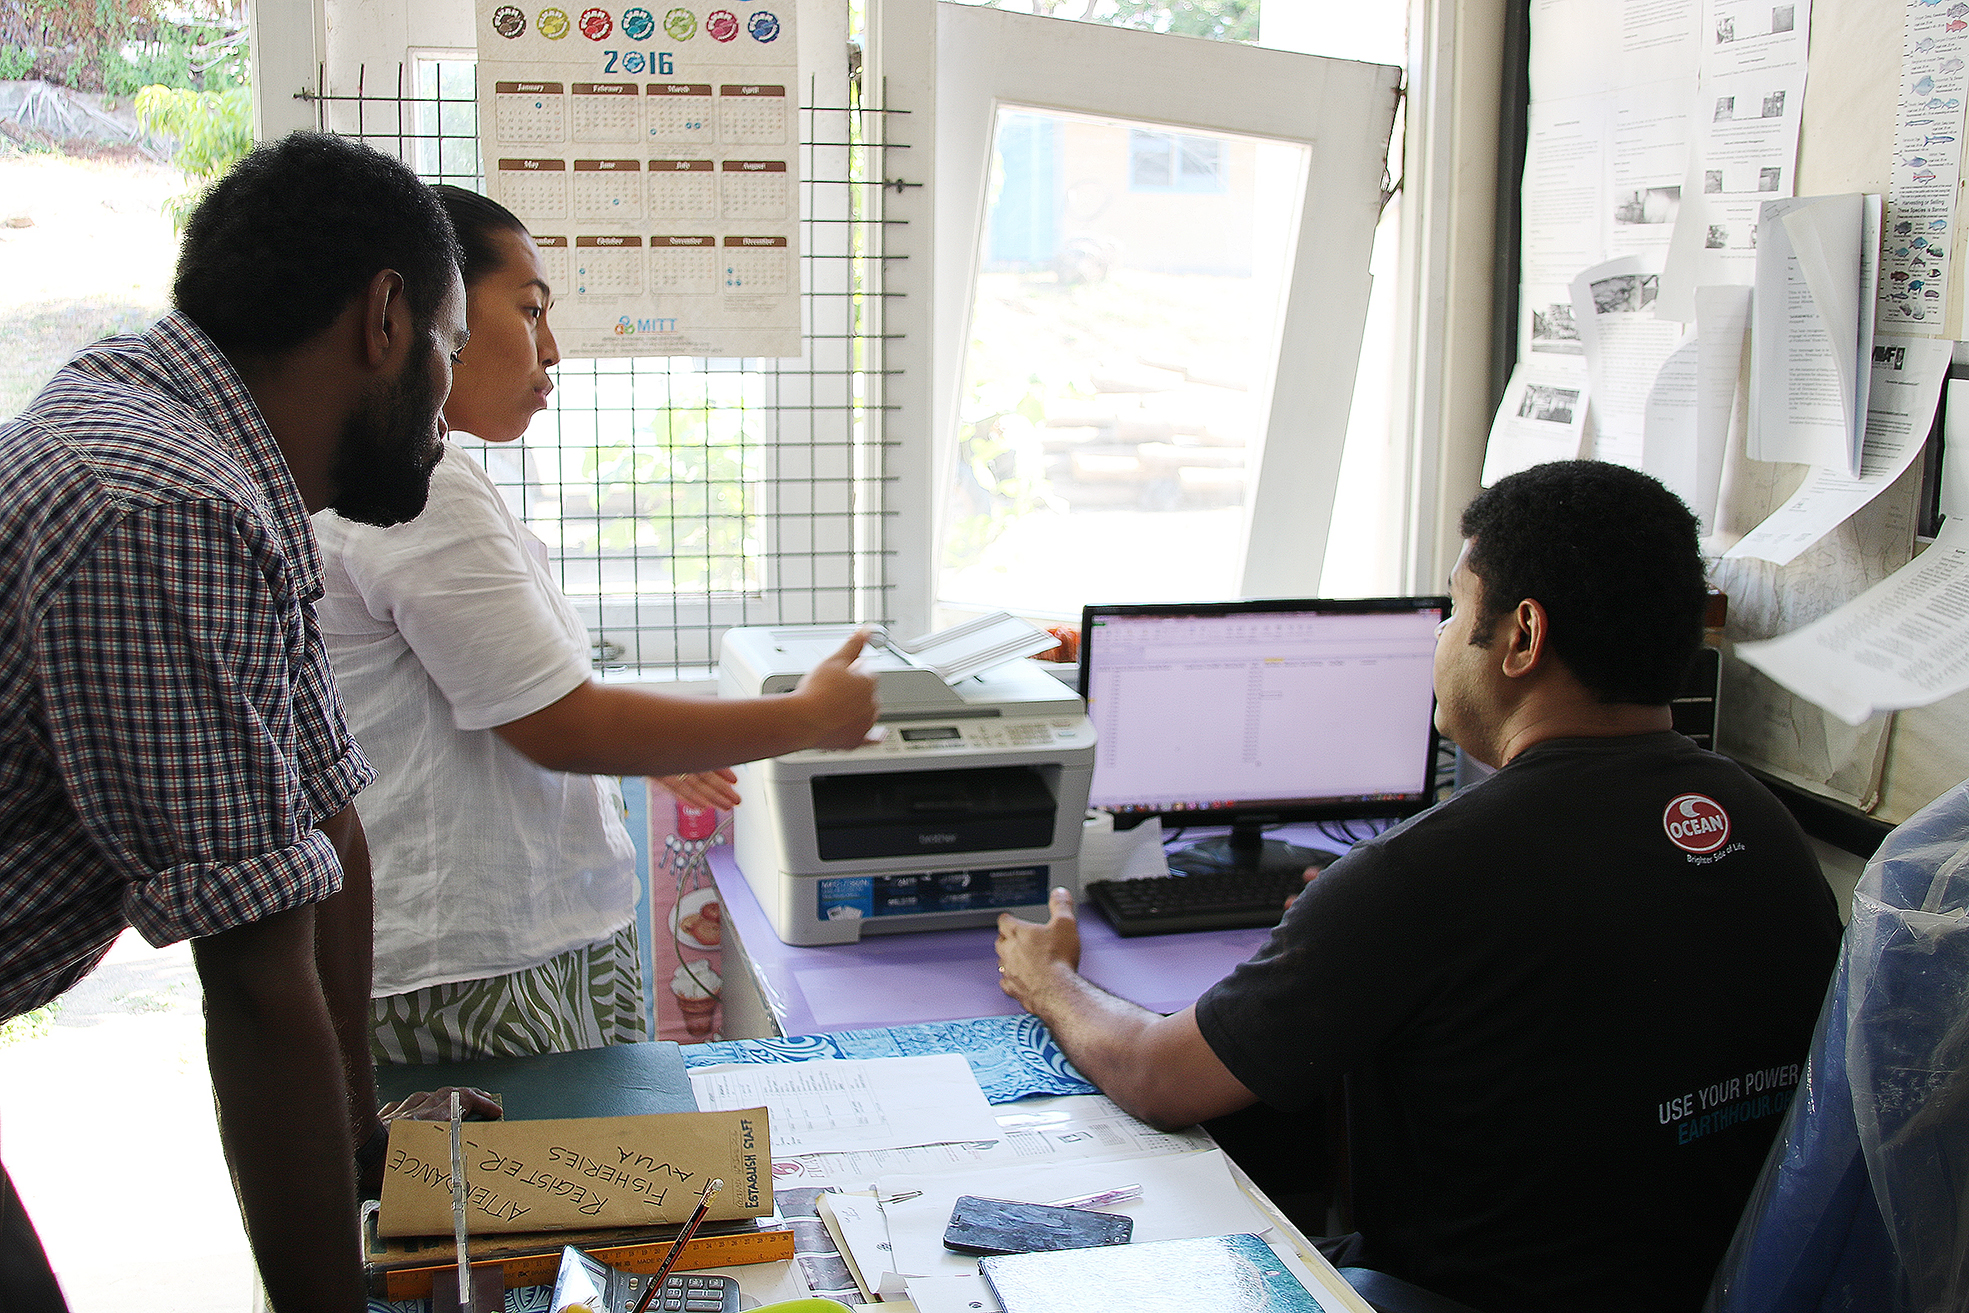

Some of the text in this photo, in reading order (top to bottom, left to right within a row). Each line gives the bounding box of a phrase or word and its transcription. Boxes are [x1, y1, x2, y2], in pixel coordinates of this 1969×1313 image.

[517, 83, 545, 93] January
[592, 85, 624, 94] February
[524, 160, 539, 170] May
[599, 161, 616, 170] June
[676, 161, 691, 171] July
[637, 318, 678, 331] MITT
[1669, 814, 1724, 839] OCEAN
[1687, 842, 1746, 866] Brighter Side of Life
[1658, 1063, 1799, 1125] USE YOUR POWER
[741, 1118, 756, 1150] STAFF
[479, 1149, 608, 1216] REGISTER
[549, 1146, 669, 1207] FISHERIES
